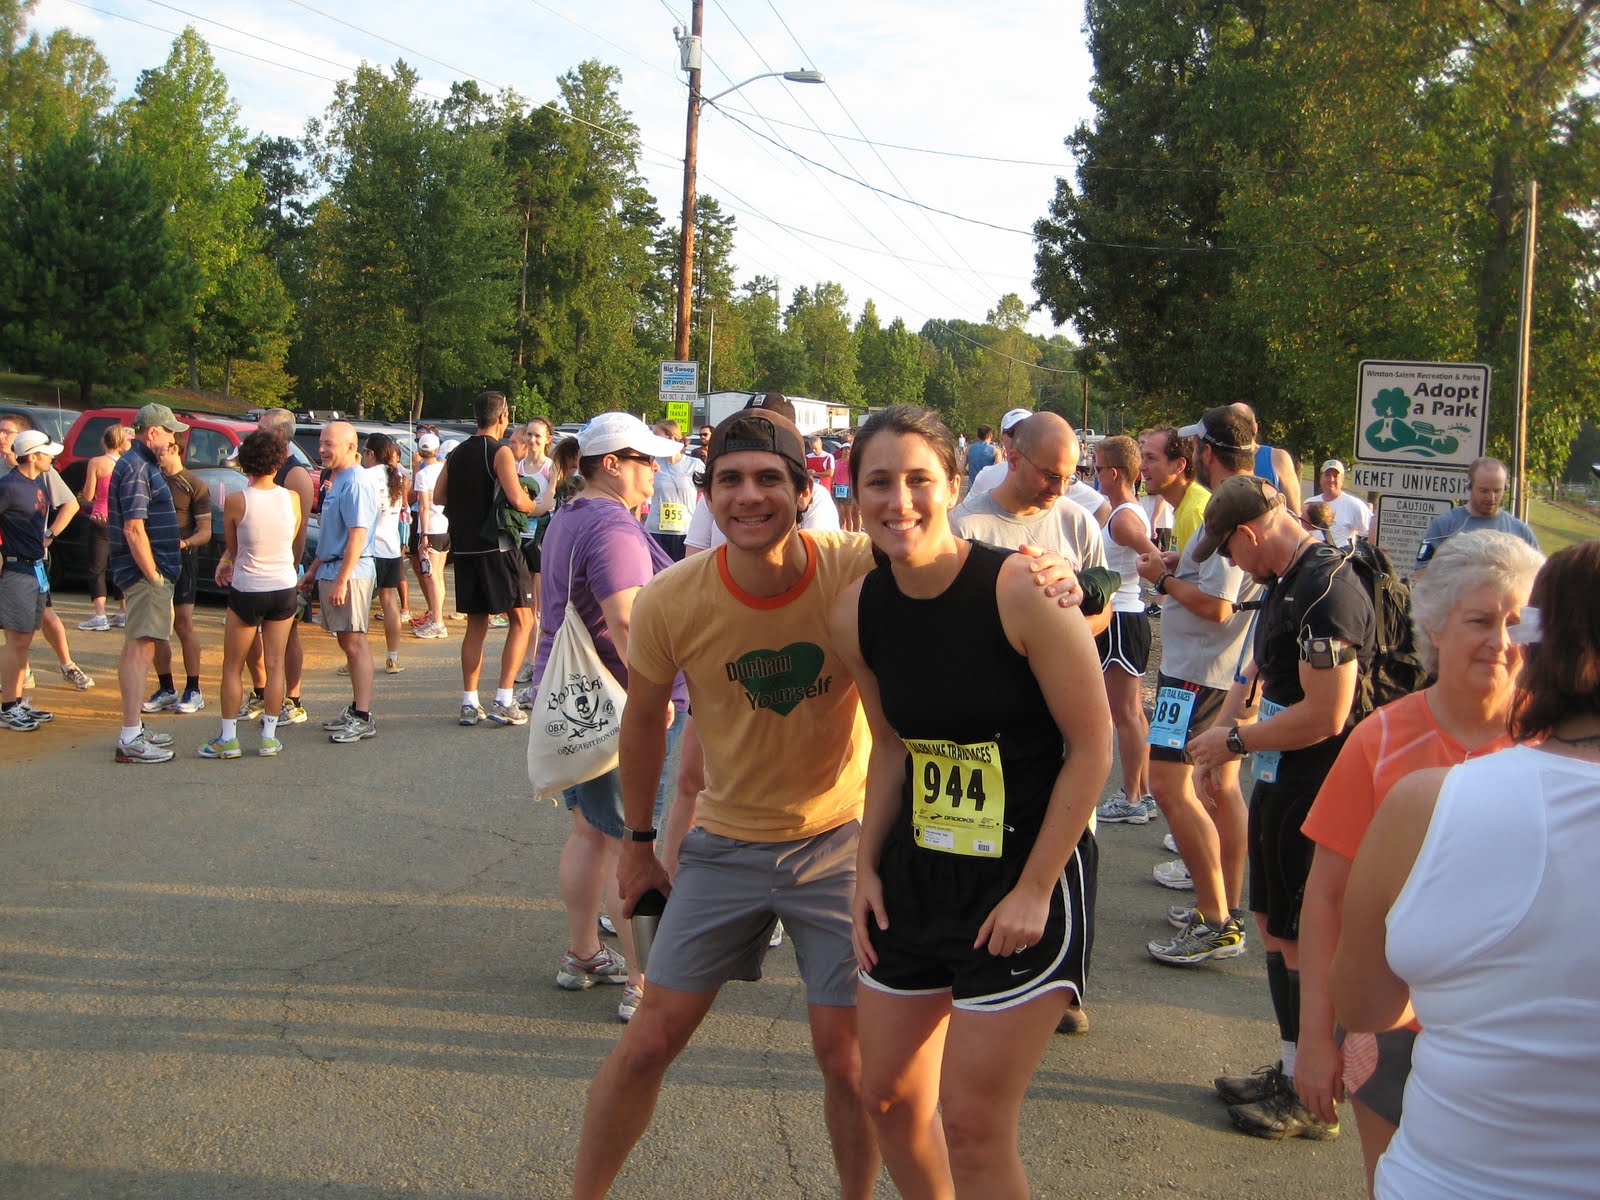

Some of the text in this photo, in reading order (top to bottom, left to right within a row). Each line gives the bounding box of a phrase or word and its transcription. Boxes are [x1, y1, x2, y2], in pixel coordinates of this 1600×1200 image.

[1366, 370, 1415, 379] Winston-Salem
[1417, 372, 1453, 380] Recreation
[1413, 382, 1479, 403] Adopt
[1412, 401, 1477, 417] a Park
[1354, 470, 1467, 494] KEMET UNIVERSIT
[664, 509, 683, 520] 955
[1396, 501, 1435, 512] CAUTION
[725, 656, 792, 682] Durham
[547, 675, 603, 712] BOOTYBA
[744, 675, 833, 711] Yourself
[1151, 701, 1180, 725] 89
[548, 723, 566, 733] OBX
[924, 761, 986, 811] 944
[944, 815, 975, 823] BROOKS
